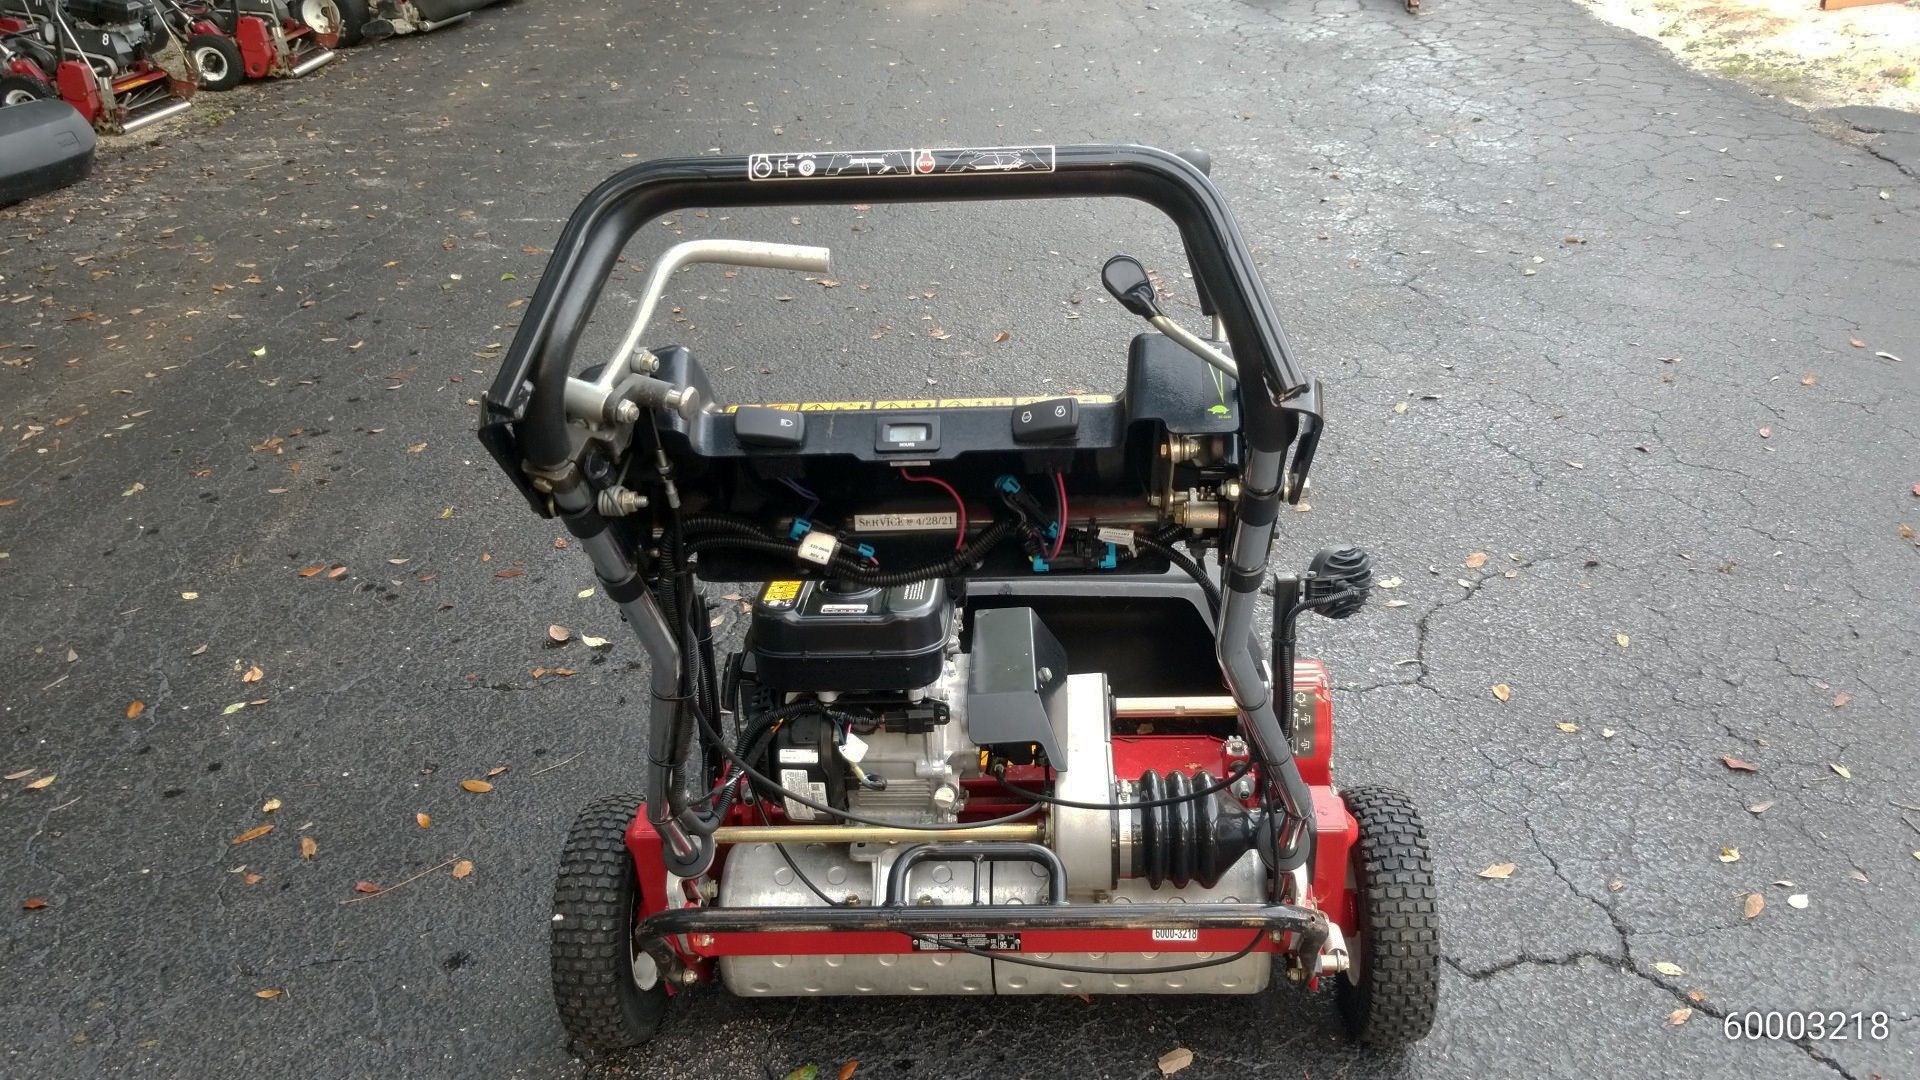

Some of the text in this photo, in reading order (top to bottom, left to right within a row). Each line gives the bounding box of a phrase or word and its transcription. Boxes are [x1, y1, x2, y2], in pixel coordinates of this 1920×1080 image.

[102, 33, 109, 46] 8
[859, 517, 904, 527] SERVICE
[915, 516, 953, 526] 4/28/21
[1155, 928, 1197, 939] 6000-3218
[999, 941, 1008, 949] 95
